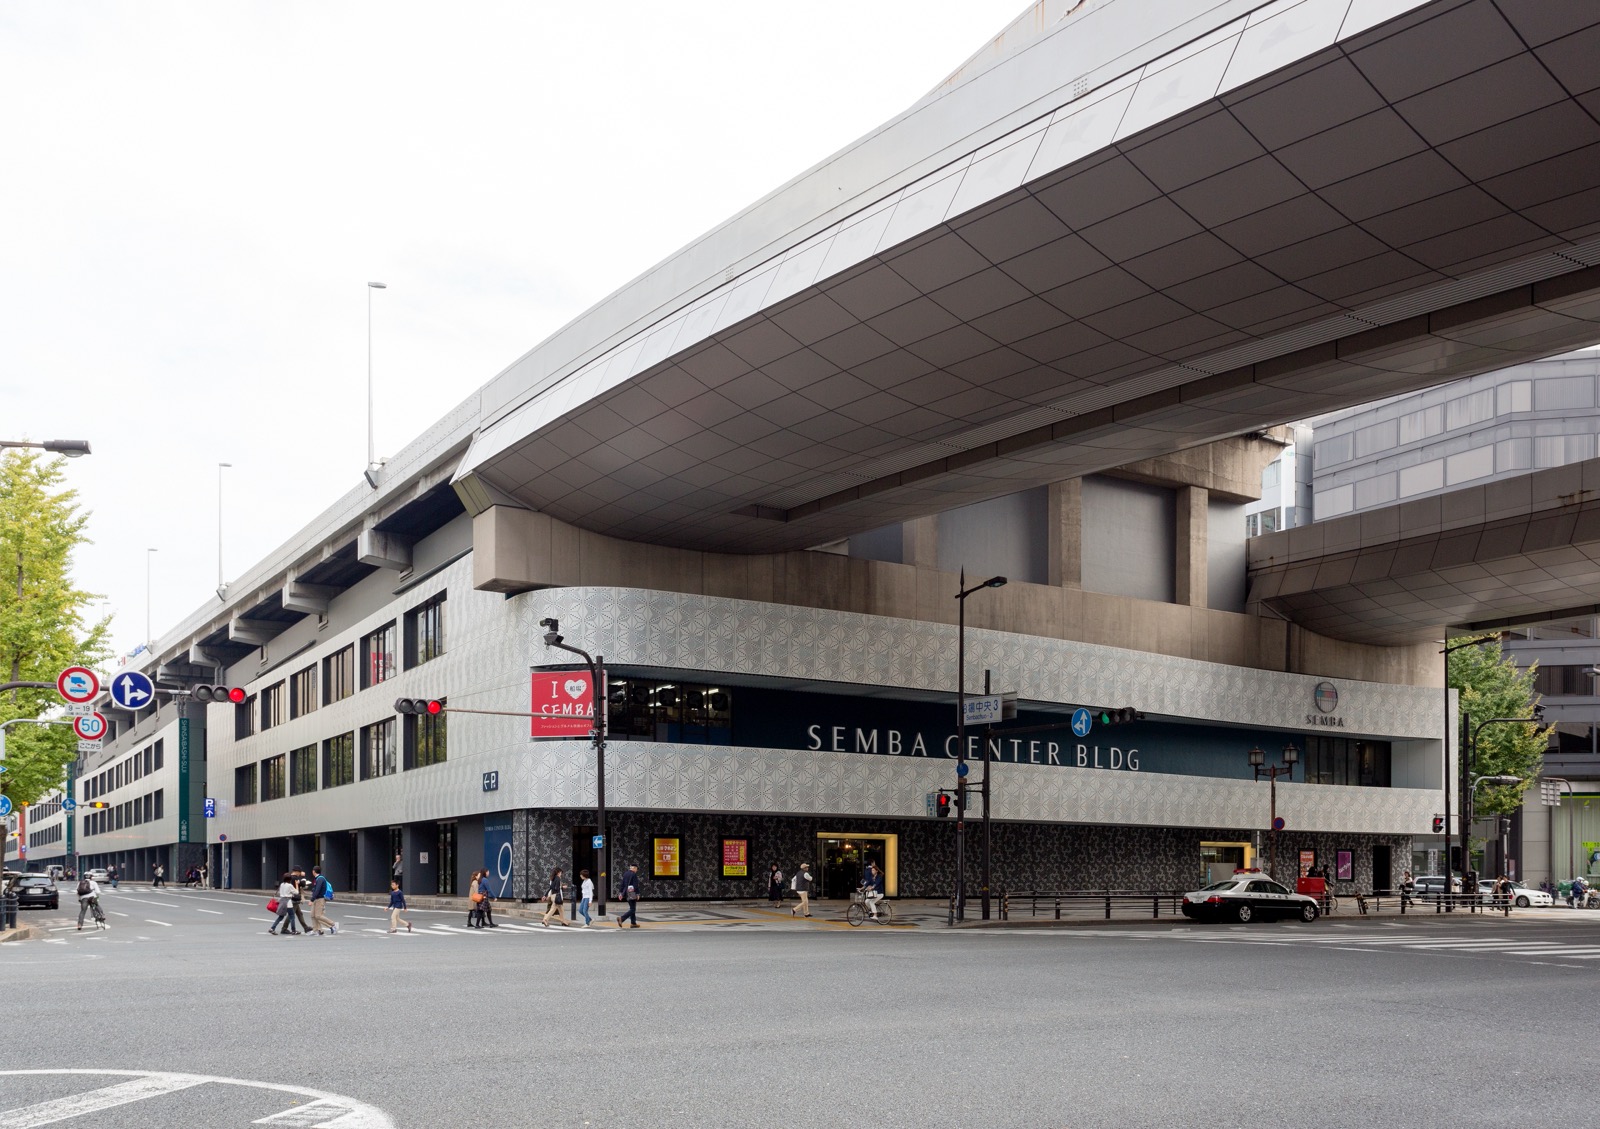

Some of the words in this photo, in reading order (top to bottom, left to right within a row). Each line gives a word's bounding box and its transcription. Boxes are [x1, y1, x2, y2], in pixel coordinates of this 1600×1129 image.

[551, 680, 559, 699] I
[540, 702, 594, 720] SEMBA
[81, 718, 100, 733] 50
[1305, 715, 1344, 728] SEMBA
[807, 724, 927, 757] SEMBA
[944, 734, 1061, 765] CENTER
[1077, 744, 1140, 771] BLDG
[205, 798, 214, 808] P
[497, 841, 513, 898] 9
